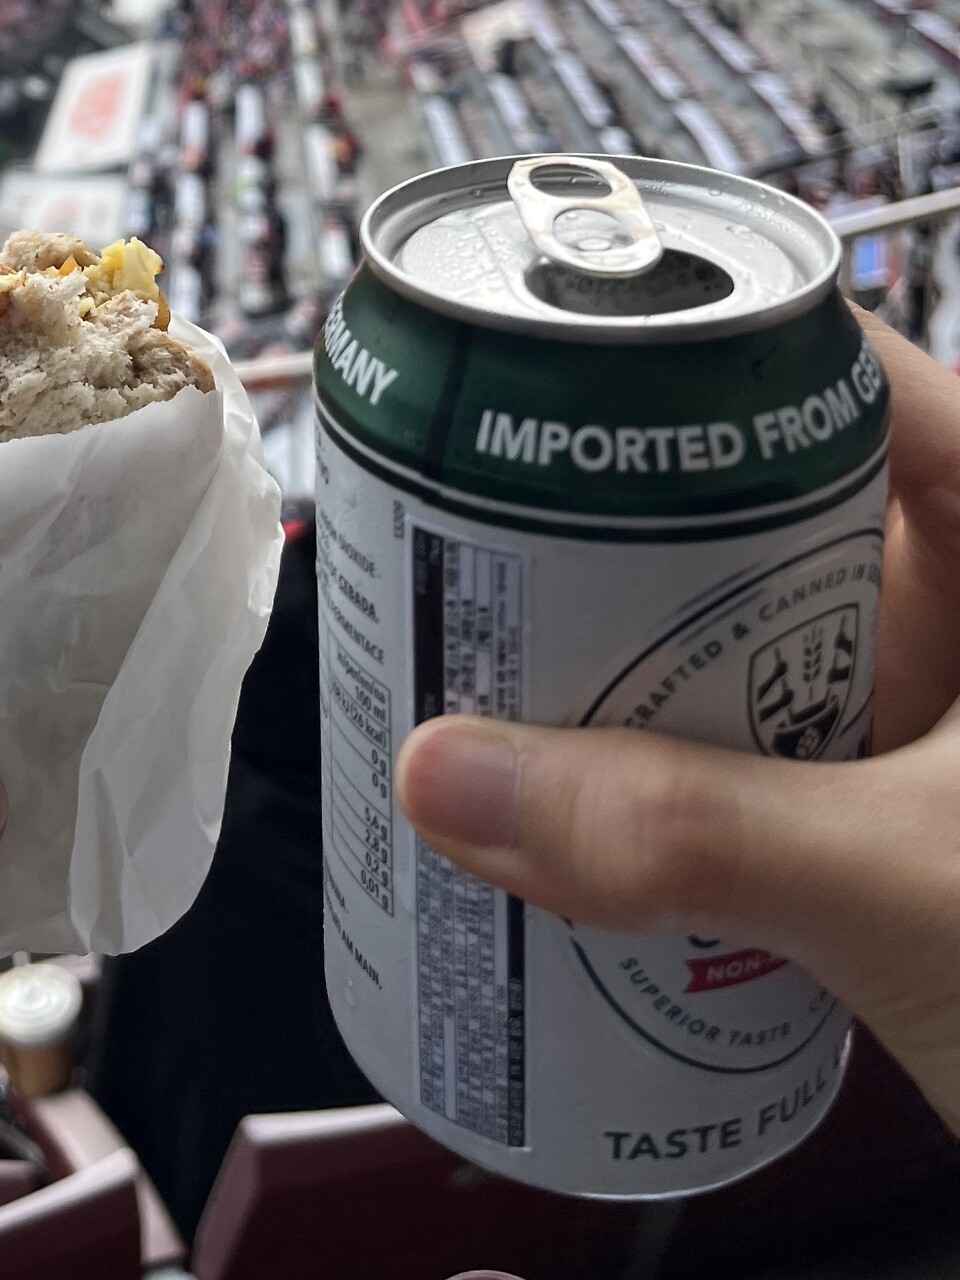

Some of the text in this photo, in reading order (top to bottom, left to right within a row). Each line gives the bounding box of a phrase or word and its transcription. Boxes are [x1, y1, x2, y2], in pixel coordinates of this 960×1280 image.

[475, 409, 746, 472] IMPORTED
[753, 378, 859, 460] FROM
[731, 622, 750, 640] &
[758, 565, 846, 621] CANNED
[355, 685, 372, 711] 100
[373, 703, 386, 723] ml
[361, 870, 379, 897] 0,01
[619, 957, 791, 1048] SUPERIOR TASTE
[604, 1067, 827, 1161] TASTE FULL
